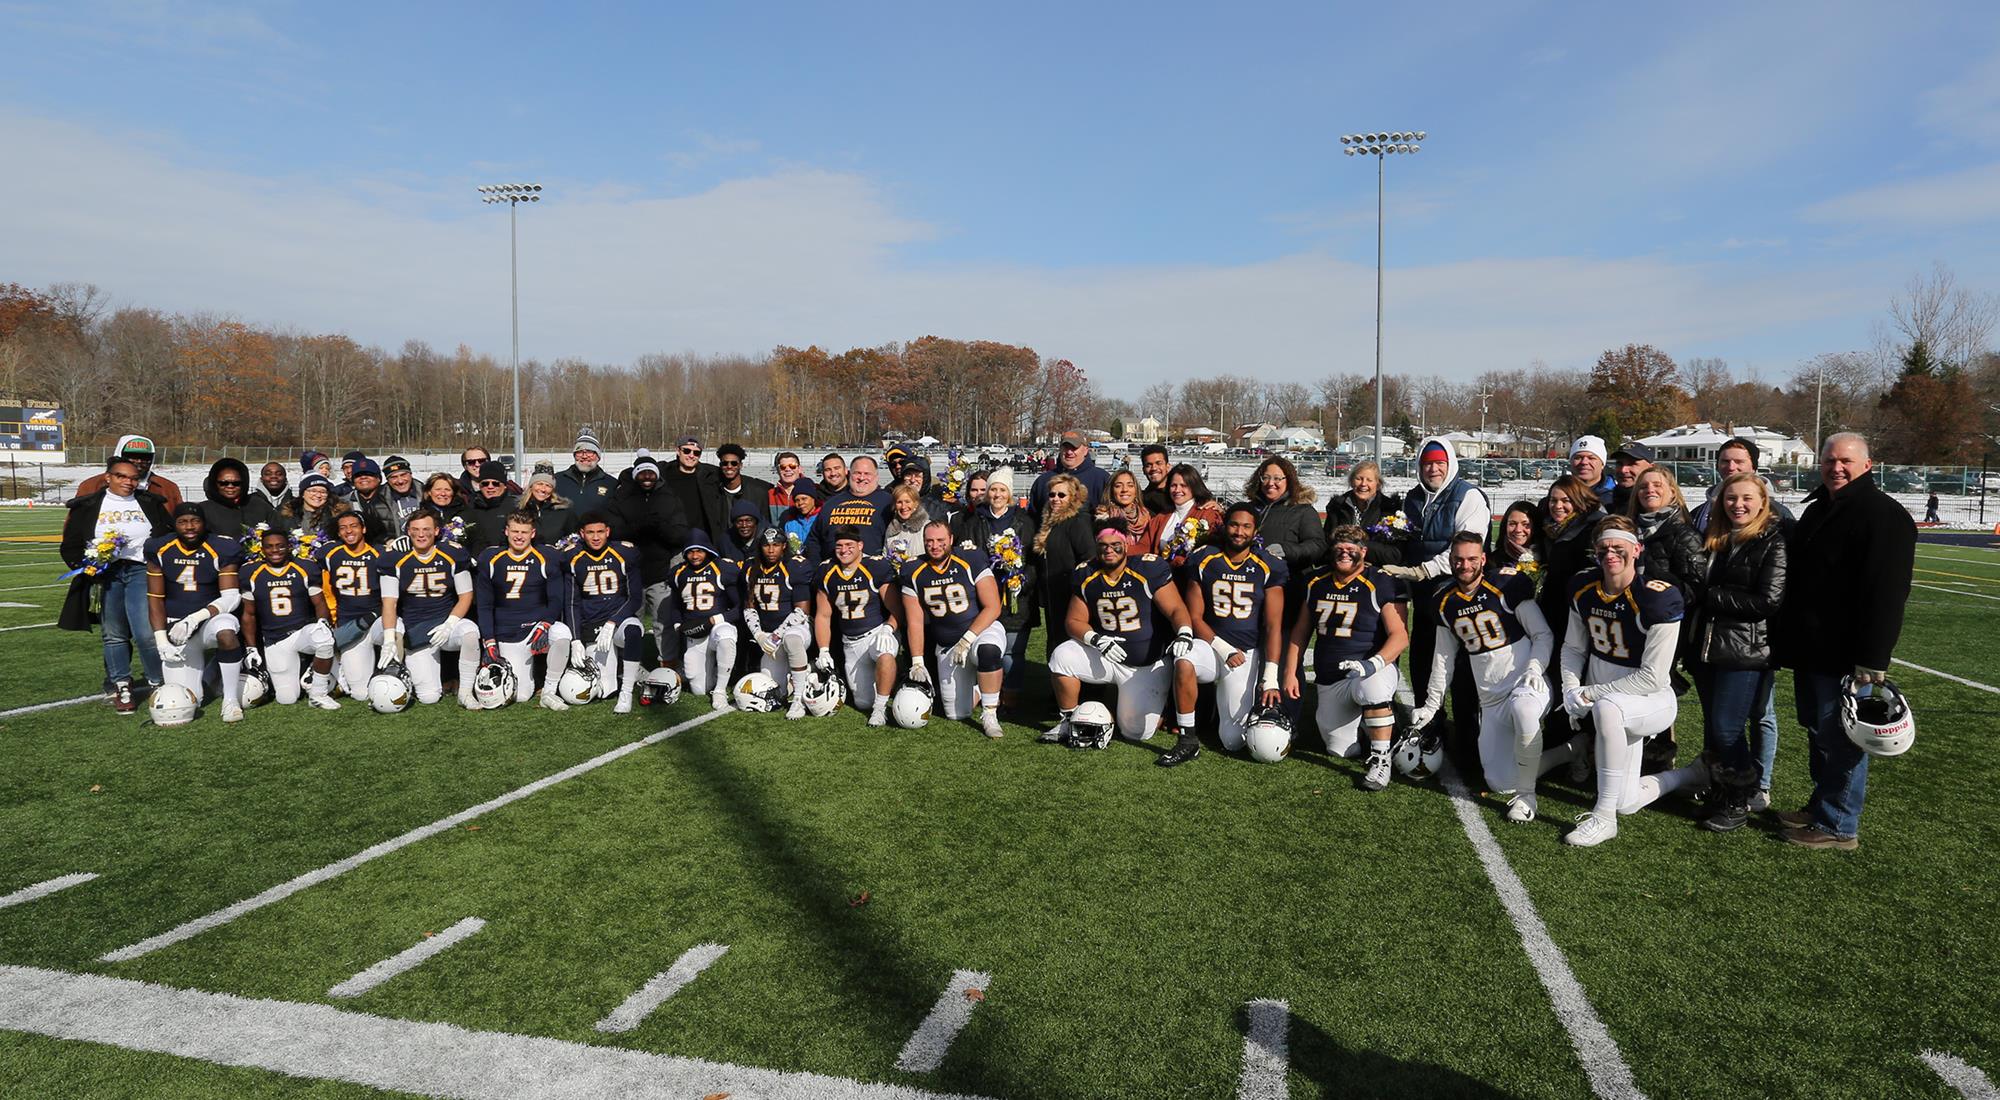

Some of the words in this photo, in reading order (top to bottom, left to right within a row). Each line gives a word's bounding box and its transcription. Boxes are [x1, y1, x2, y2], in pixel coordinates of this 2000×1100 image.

[829, 516, 872, 526] FOOTBALL
[831, 508, 876, 516] ALLEGHENY
[175, 565, 198, 592] 4
[335, 566, 371, 597] 21
[406, 572, 448, 597] 45
[505, 571, 528, 599] 7
[583, 570, 618, 595] 40
[931, 577, 954, 586] GATORS
[1221, 573, 1247, 581] GATORS
[269, 587, 292, 616] 6
[835, 589, 870, 620] 47
[923, 583, 969, 618] 58
[1102, 590, 1125, 598] GATORS
[1212, 579, 1254, 619] 65
[1325, 593, 1350, 601] GATORS
[1096, 596, 1141, 632] 62
[1315, 600, 1358, 637] 77
[1457, 604, 1483, 616] GATORS
[1591, 607, 1617, 619] GATORS
[1453, 609, 1507, 653] 80
[1588, 616, 1631, 658] 81
[1873, 720, 1909, 735] Riddell
